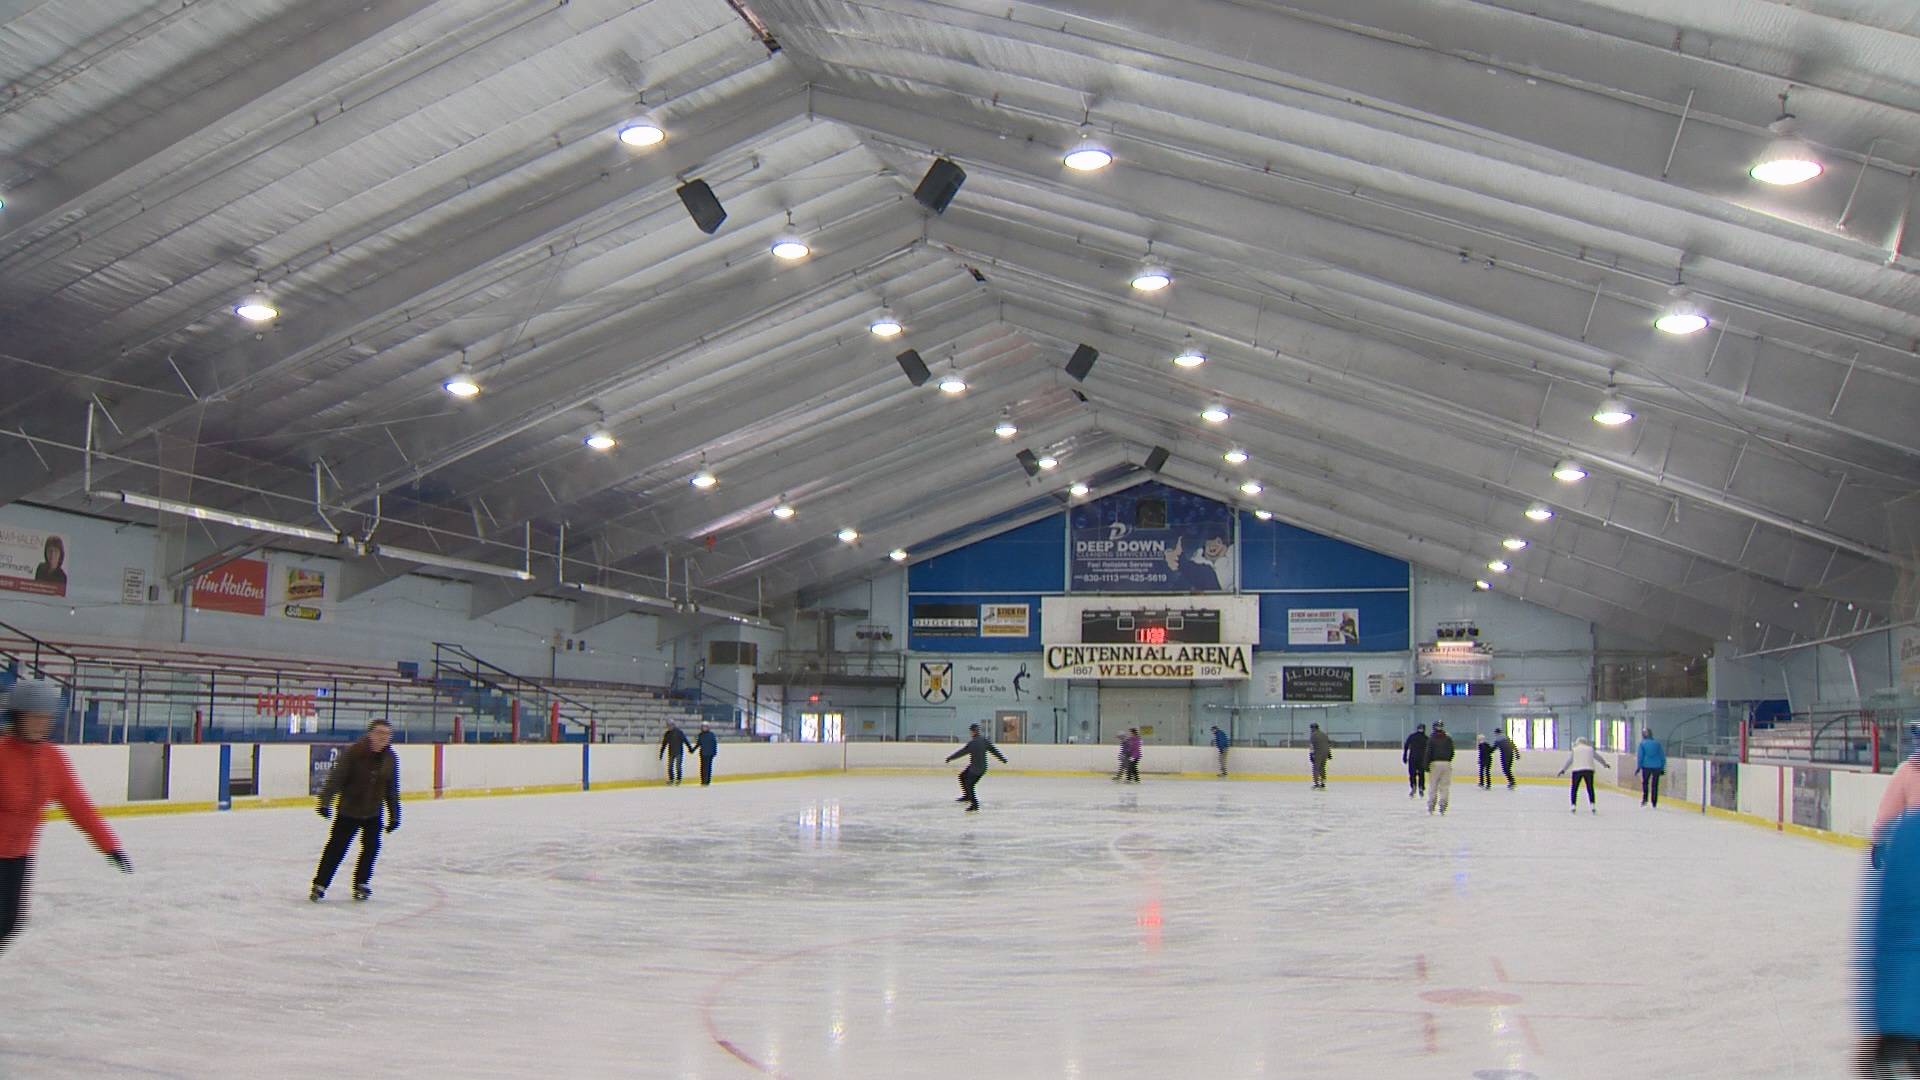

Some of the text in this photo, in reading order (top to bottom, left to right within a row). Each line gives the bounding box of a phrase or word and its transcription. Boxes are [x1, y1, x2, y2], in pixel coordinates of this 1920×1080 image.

[1077, 541, 1165, 552] DEEP DOWN
[196, 570, 264, 599] Tim Hortons
[914, 620, 977, 628] DUGGER'S
[1047, 645, 1249, 675] CENTENNIAL ARENA
[1073, 664, 1222, 677] 1867 WELCOME 1967
[1304, 667, 1351, 681] DUFOUR
[970, 676, 995, 684] Halifax
[959, 685, 985, 693] Skating
[257, 692, 317, 717] HOME
[314, 761, 333, 771] DEEP
